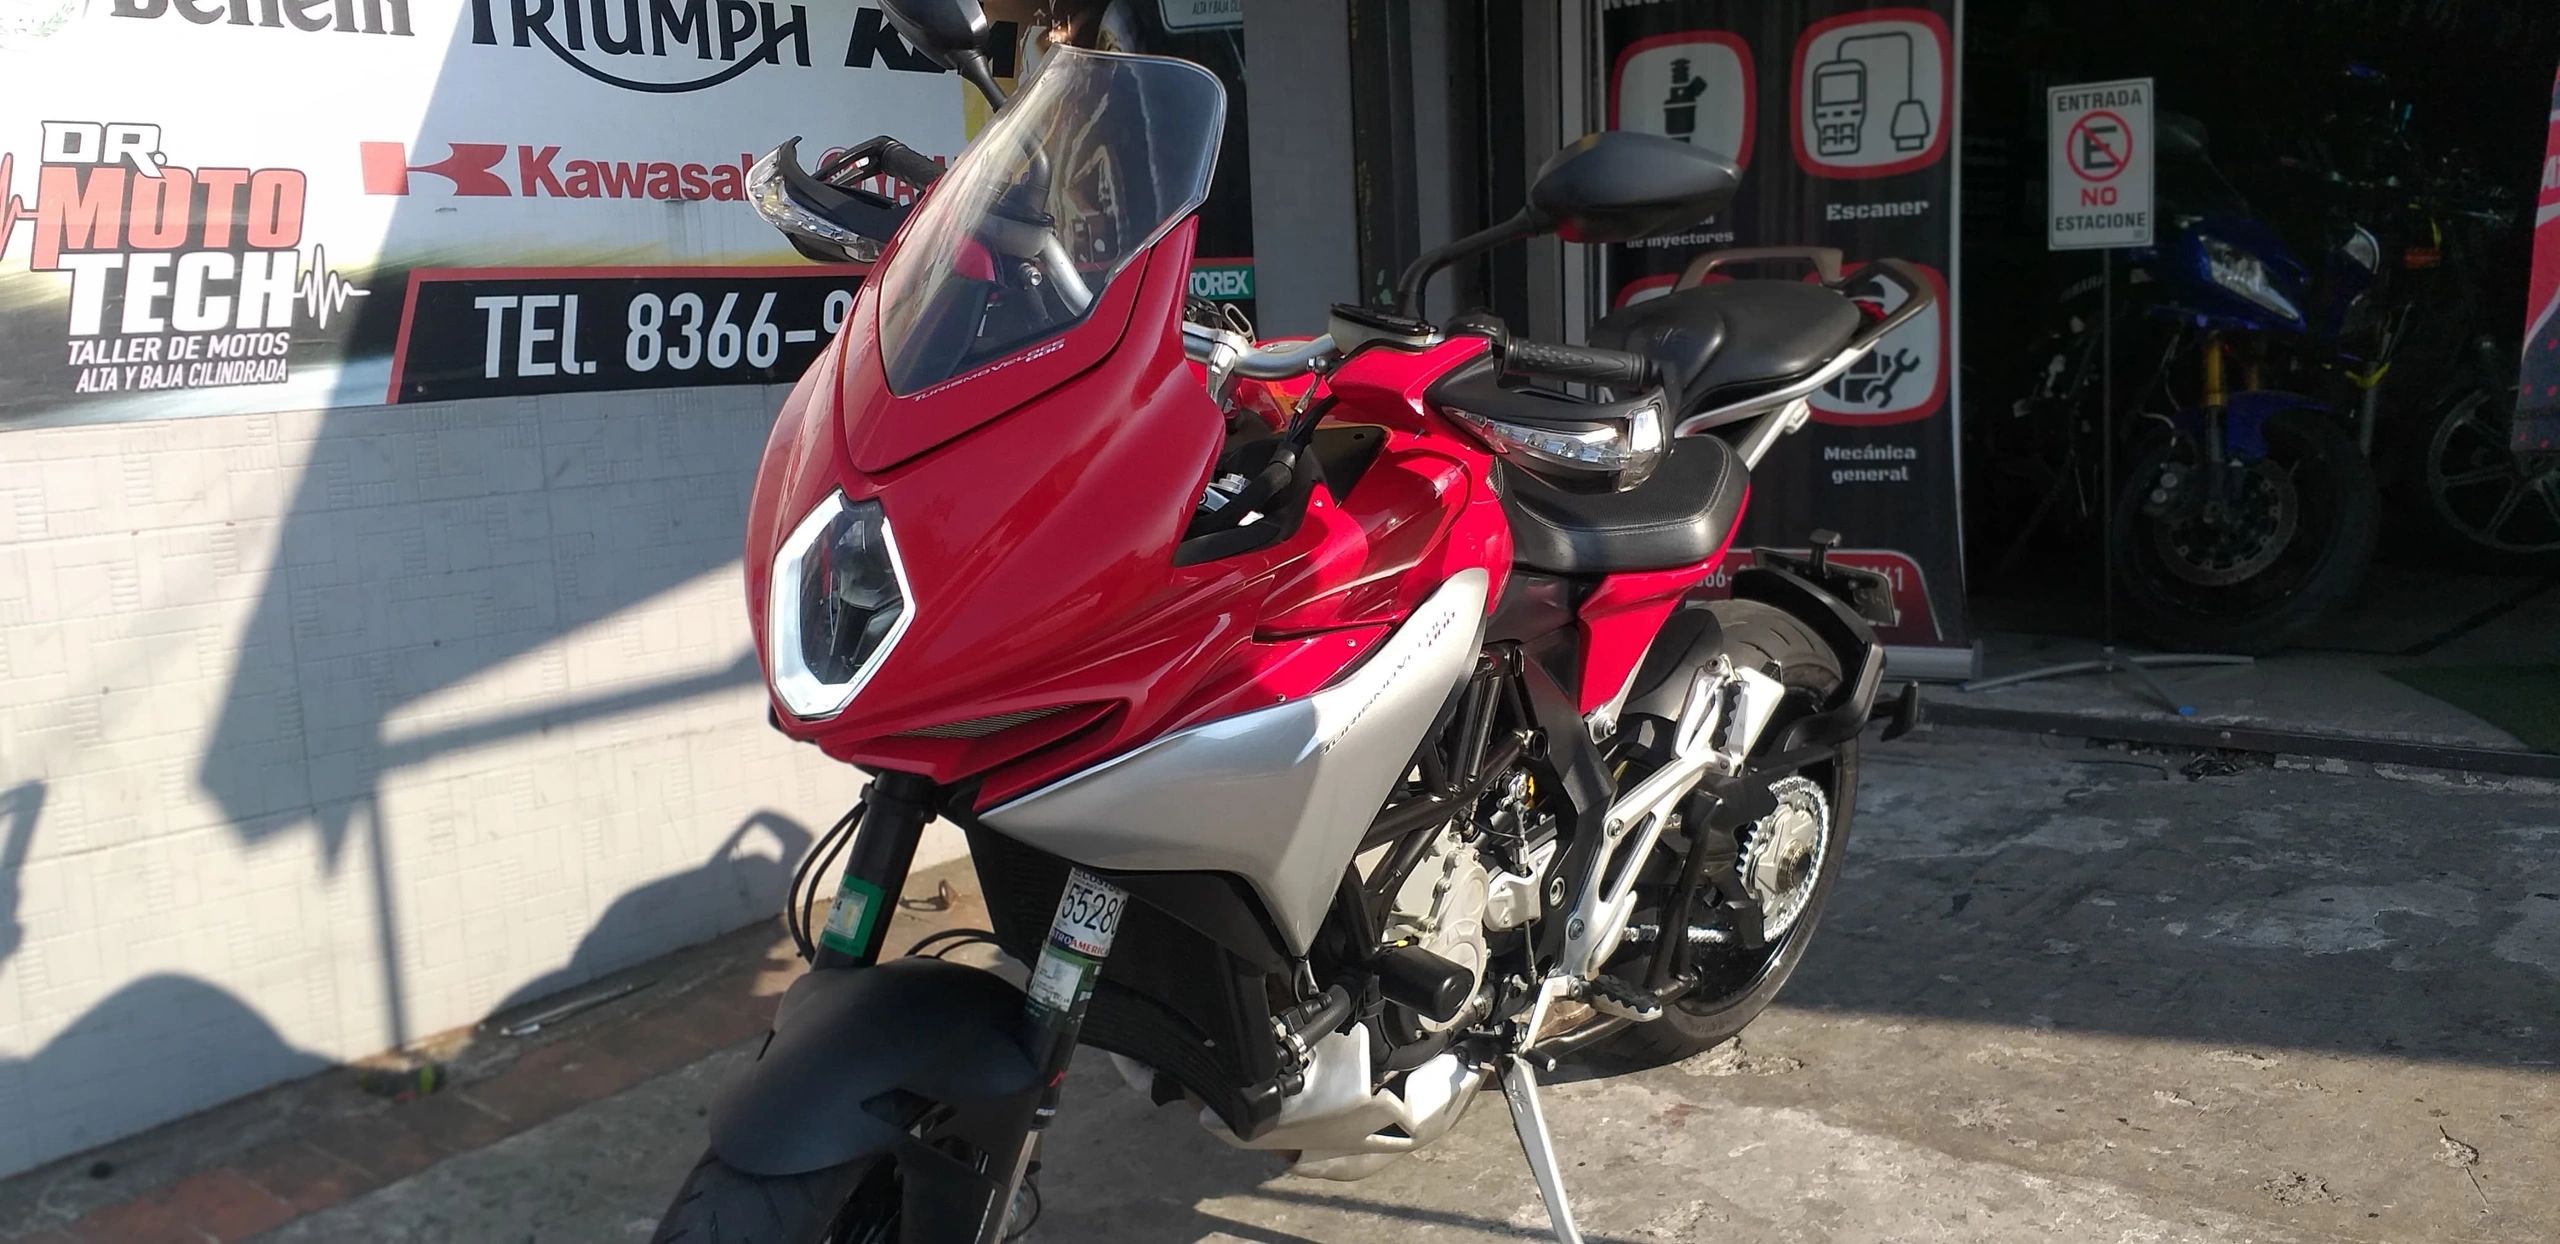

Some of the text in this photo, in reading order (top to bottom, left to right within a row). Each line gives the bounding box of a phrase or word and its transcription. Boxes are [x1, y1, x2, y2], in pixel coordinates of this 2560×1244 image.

[471, 0, 812, 67] TRIUMPH
[2056, 88, 2143, 112] ENTRADA
[41, 120, 168, 180] DR.
[1826, 200, 1929, 222] Escaner
[2080, 186, 2118, 207] NO
[30, 165, 307, 271] MOTO
[2055, 212, 2147, 232] ESTACIONE
[58, 248, 301, 336] TECH
[68, 331, 290, 367] TALLER DE MOTOS
[75, 358, 288, 394] ALTA Y BAJA CILINDRADA
[1824, 444, 1917, 463] Mecánica
[1832, 465, 1909, 485] general
